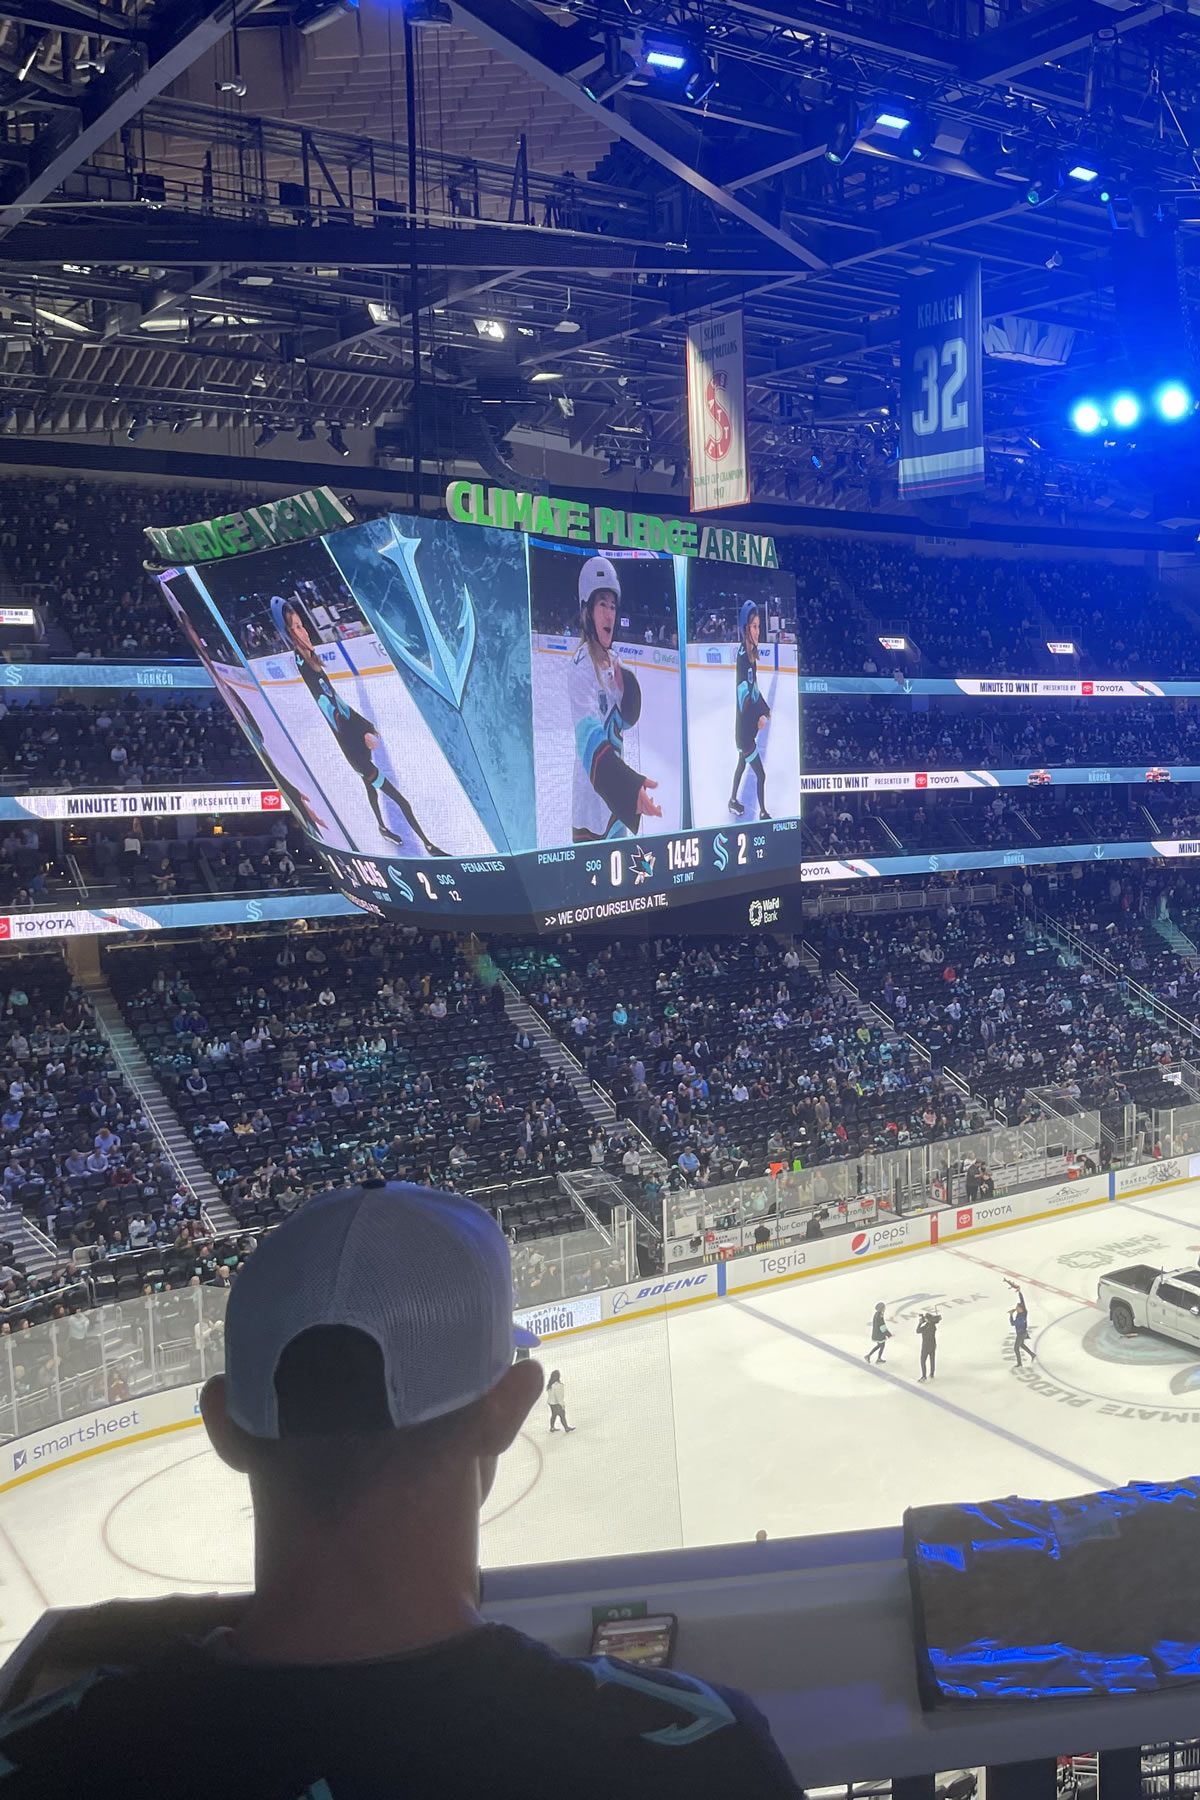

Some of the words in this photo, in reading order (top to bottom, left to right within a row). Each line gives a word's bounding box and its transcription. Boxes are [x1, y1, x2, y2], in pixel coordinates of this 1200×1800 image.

[917, 293, 963, 329] KRAKEN
[912, 337, 969, 436] 32
[446, 481, 590, 541] CLIMATE
[595, 506, 698, 557] PLEDGE
[700, 526, 779, 569] ARENA
[980, 681, 1004, 693] MINUTE
[1005, 682, 1014, 692] TO
[1015, 682, 1031, 693] WIN
[1031, 682, 1038, 692] IT
[800, 776, 831, 789] MINUTE
[832, 776, 843, 789] TO
[844, 776, 859, 788] WIN
[860, 776, 869, 788] IT
[930, 775, 959, 784] TOYOTA
[67, 797, 118, 815] MINUTE
[122, 797, 137, 812] TO
[142, 796, 167, 812] WIN
[169, 796, 182, 811] IT
[193, 797, 238, 807] PRESENTED
[241, 796, 251, 805] BY
[772, 821, 798, 832] PENALTIES
[753, 835, 766, 847] SOG
[667, 837, 700, 871] 14:45
[737, 833, 747, 865] 2
[756, 849, 764, 859] 12
[538, 850, 576, 865] PENALTIES
[460, 860, 505, 873] PENALTIES
[585, 859, 602, 872] SOG
[610, 850, 622, 887] 0
[801, 866, 830, 876] OYOTA
[436, 874, 456, 885] SOG
[591, 875, 597, 886] 4
[673, 874, 684, 885] 1ST
[684, 872, 695, 884] INT
[416, 871, 438, 900] 2
[449, 890, 462, 901] 12
[558, 911, 574, 926] WE
[575, 906, 594, 922] GOT
[595, 896, 645, 918] OURSELVES
[645, 896, 654, 908] A
[653, 893, 669, 907] TIE,
[763, 897, 780, 911] WaFd
[763, 911, 779, 924] Bank
[16, 919, 75, 932] TOYOTA
[1120, 1175, 1147, 1187] KRAKEN
[934, 1189, 941, 1199] G
[976, 1204, 1012, 1221] TOYOTA
[873, 1222, 909, 1245] pepsi
[760, 1251, 806, 1274] Tegria
[636, 1274, 708, 1299] BOEING
[533, 1306, 567, 1319] SEATTLE
[526, 1311, 574, 1335] KRAKEN
[33, 1410, 140, 1460] smartsheet
